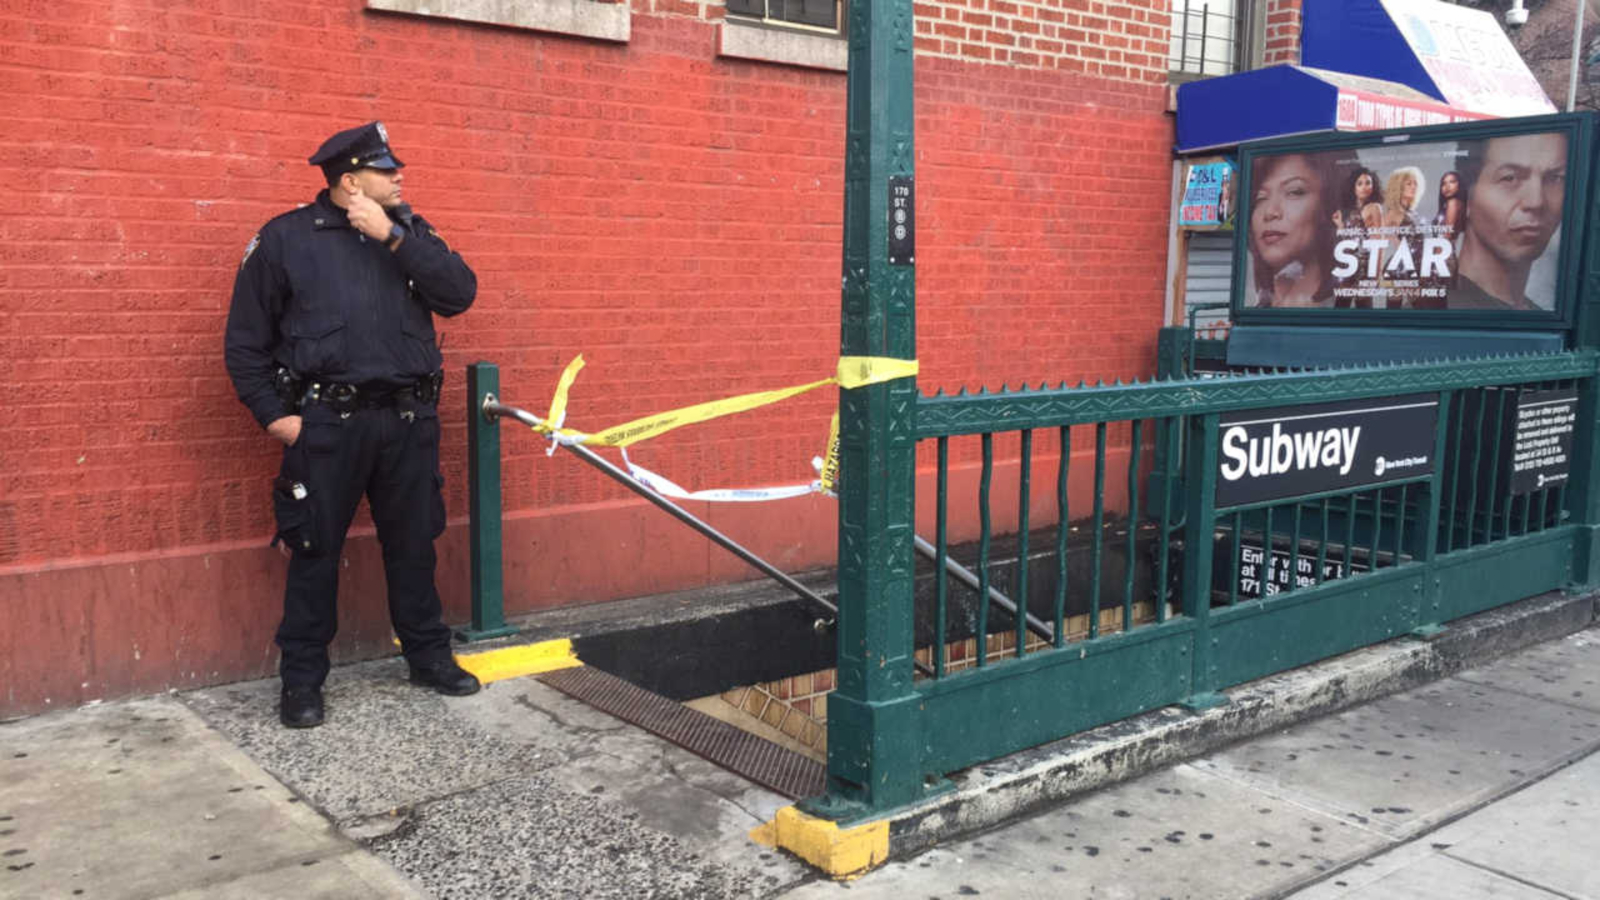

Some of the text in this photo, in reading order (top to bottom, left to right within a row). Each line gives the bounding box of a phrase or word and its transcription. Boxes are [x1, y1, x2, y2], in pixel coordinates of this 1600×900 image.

[1331, 236, 1453, 278] STAR
[1220, 423, 1361, 481] Subway
[1242, 549, 1278, 568] Entr
[1241, 565, 1255, 577] at
[1241, 579, 1260, 594] 171
